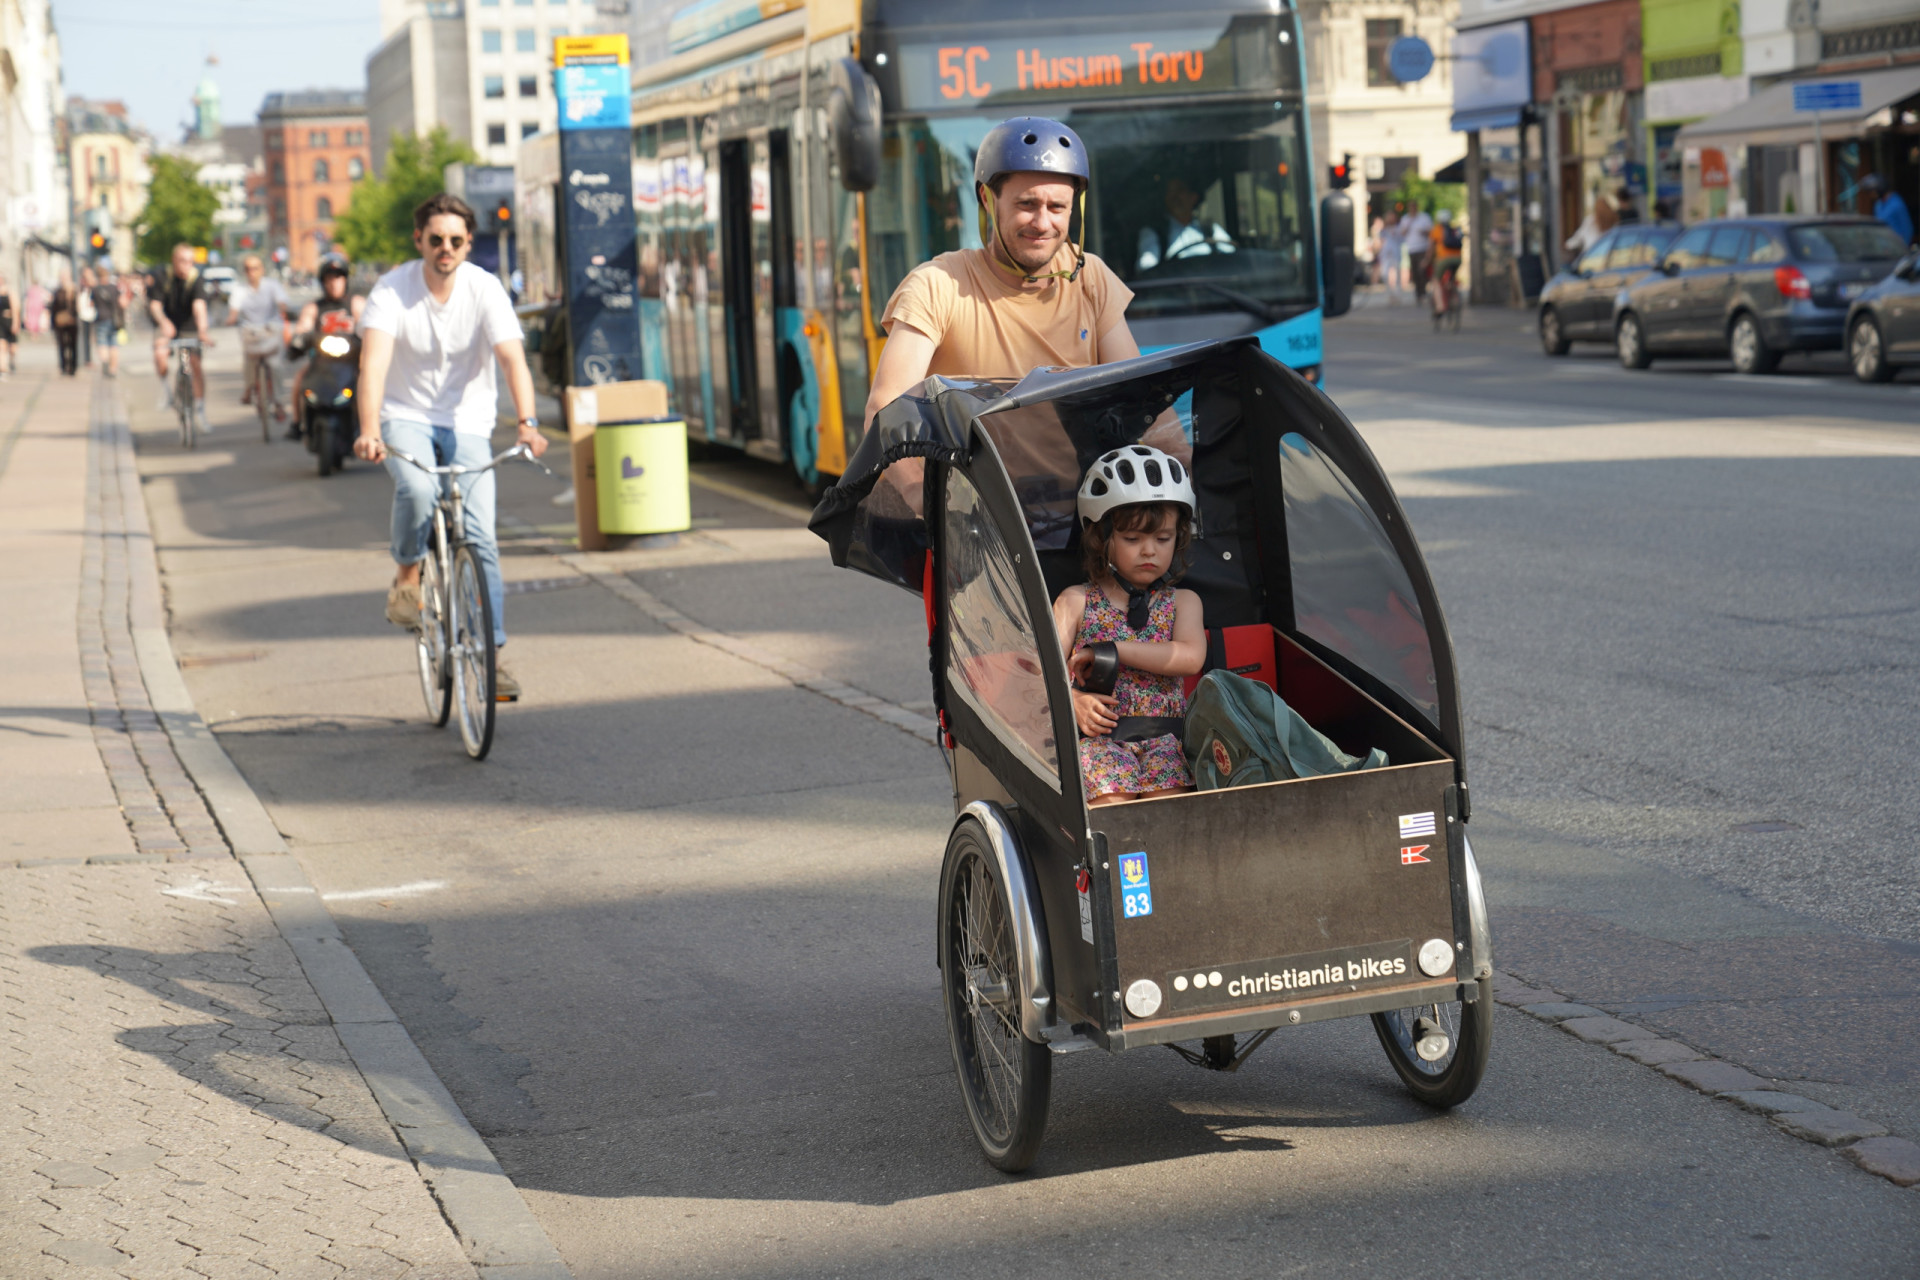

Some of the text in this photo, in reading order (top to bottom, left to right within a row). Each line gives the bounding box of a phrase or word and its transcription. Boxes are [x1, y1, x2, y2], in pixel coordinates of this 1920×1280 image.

[938, 42, 1204, 99] 5C Husum Torv
[1125, 893, 1150, 916] 83
[1228, 957, 1406, 997] christiania bikes
